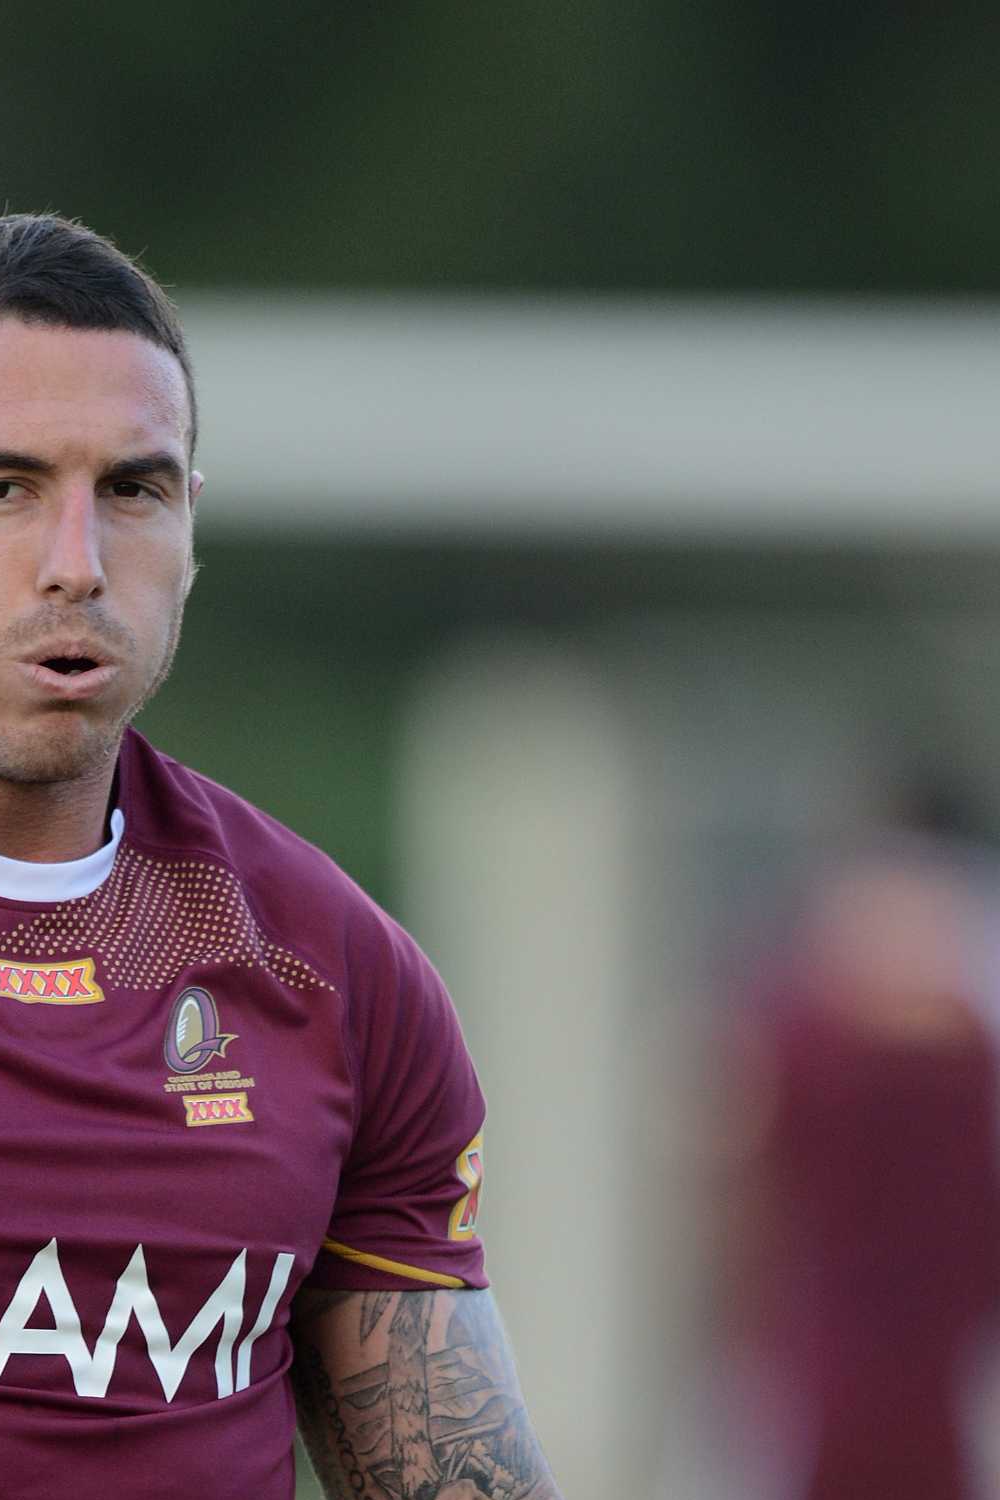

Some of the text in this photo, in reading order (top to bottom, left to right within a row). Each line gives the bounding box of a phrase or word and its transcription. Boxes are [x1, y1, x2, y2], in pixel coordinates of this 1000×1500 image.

[163, 1077, 256, 1093] STATE OF ORIGIN
[188, 1098, 246, 1121] XXXX
